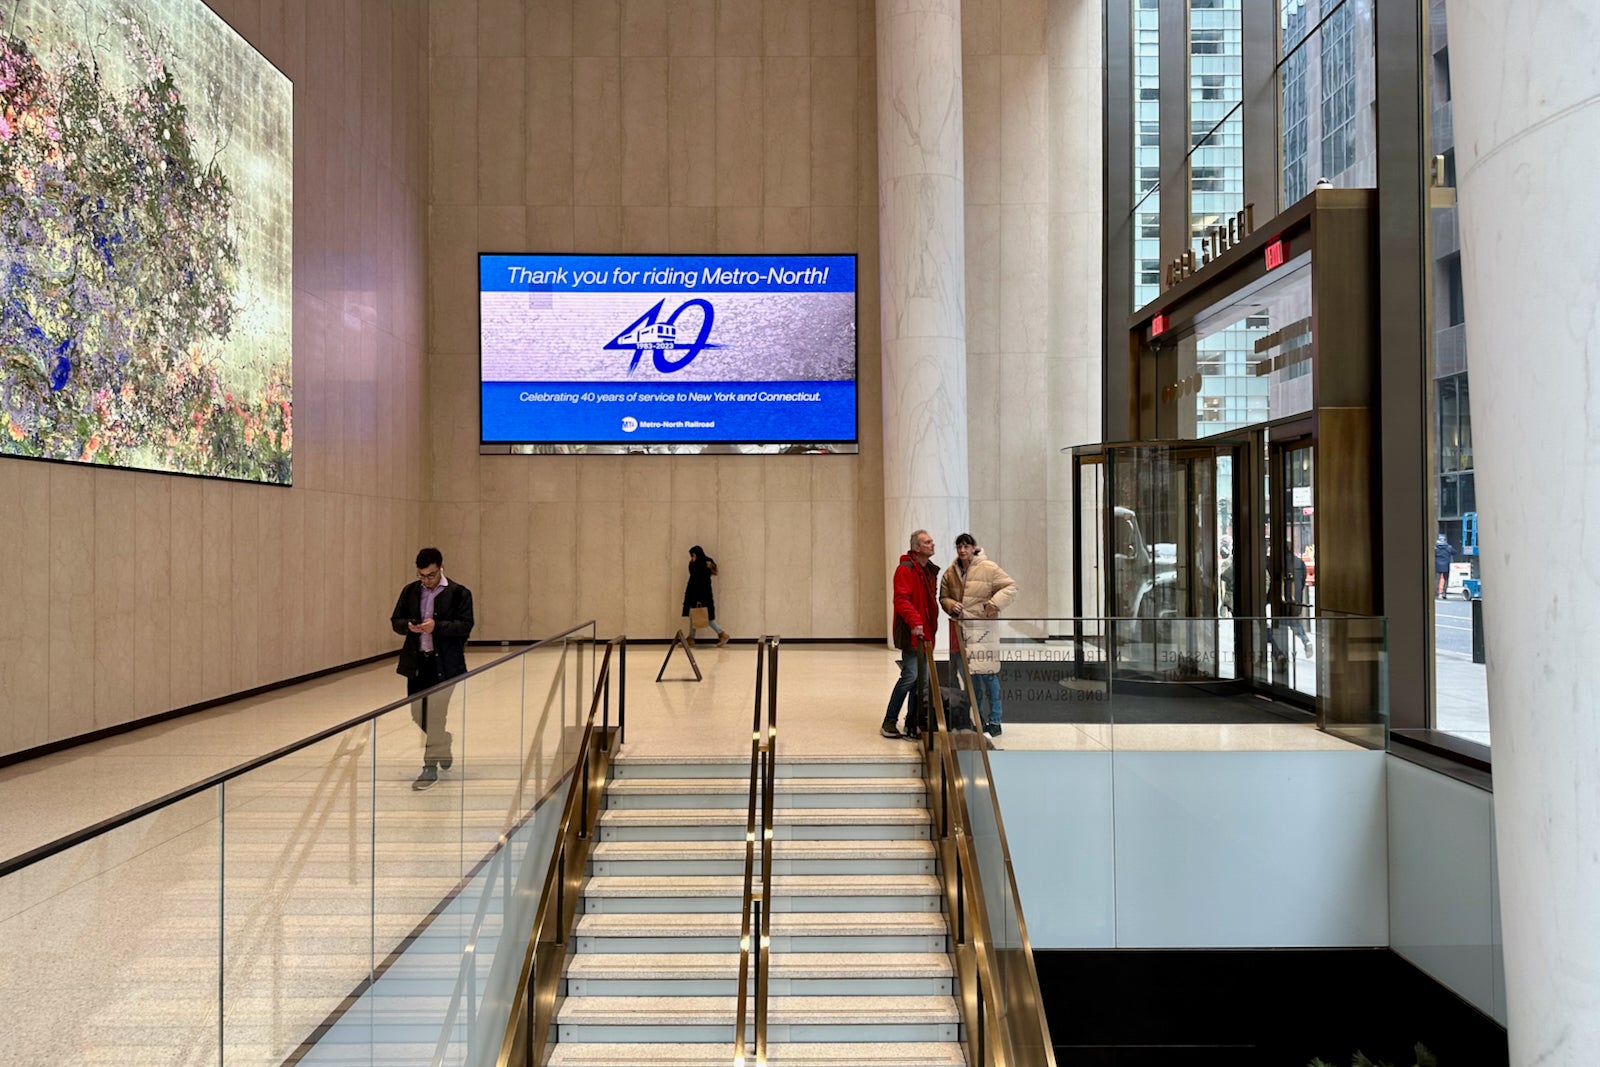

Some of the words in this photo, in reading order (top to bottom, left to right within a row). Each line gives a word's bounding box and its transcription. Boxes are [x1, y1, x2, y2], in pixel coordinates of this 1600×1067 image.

[1202, 203, 1255, 267] STREET
[507, 266, 569, 285] Thank
[572, 270, 609, 288] you
[612, 266, 641, 285] for
[642, 267, 699, 289] riding
[701, 266, 830, 285] Metro-North!
[603, 297, 716, 377] 40
[519, 391, 580, 404] Celebrating
[580, 392, 596, 402] 40
[596, 394, 625, 404] years
[626, 392, 638, 402] of
[637, 393, 676, 402] service
[676, 392, 688, 402] to
[688, 392, 713, 402] New
[713, 392, 737, 402] York
[736, 392, 758, 402] and
[757, 391, 822, 402] Connecticut.
[639, 420, 684, 429] Metro-North
[684, 420, 715, 429] Railroad
